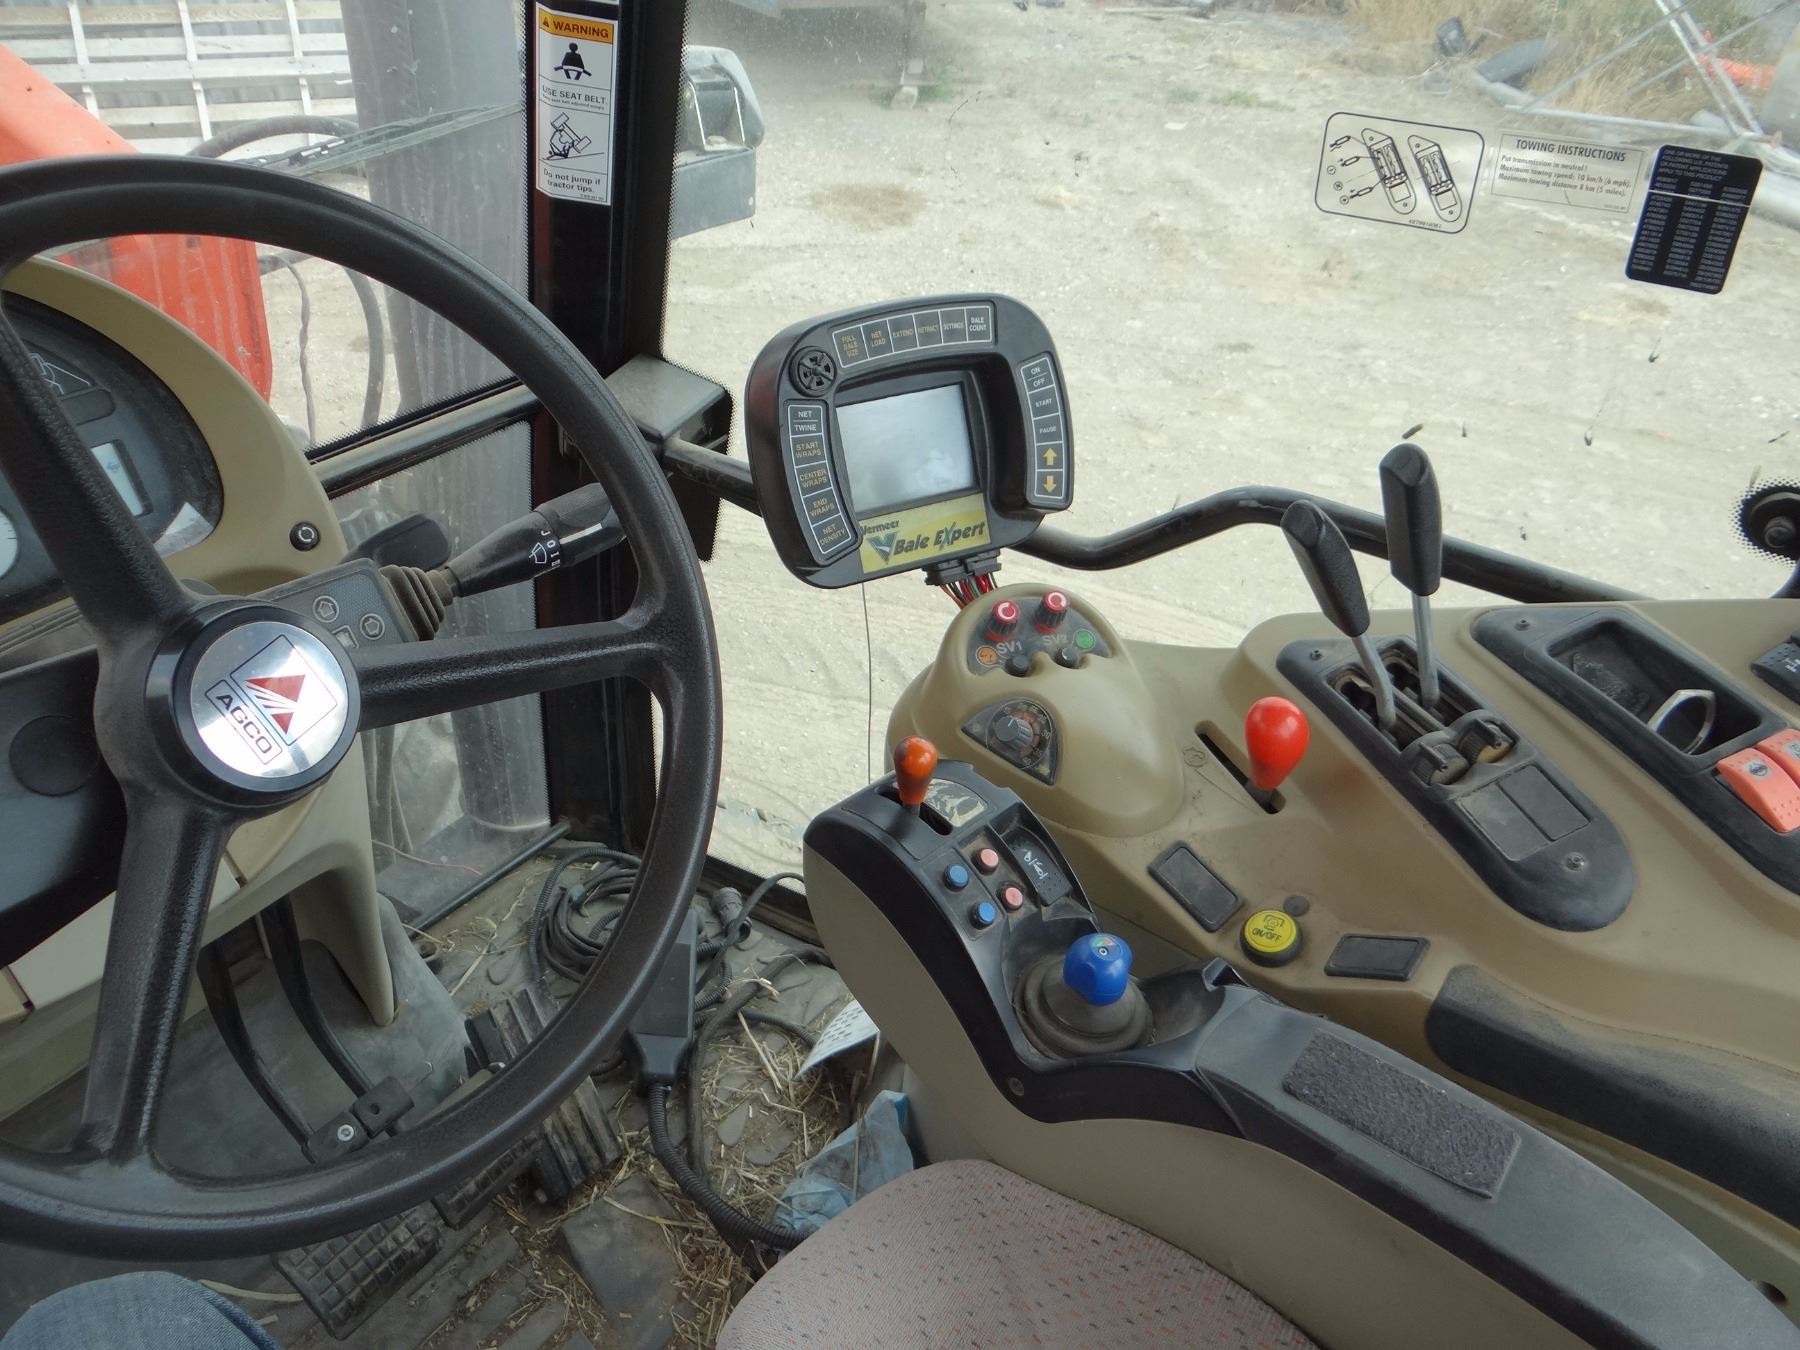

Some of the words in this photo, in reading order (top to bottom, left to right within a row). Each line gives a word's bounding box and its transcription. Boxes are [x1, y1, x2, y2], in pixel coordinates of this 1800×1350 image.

[553, 20, 609, 38] WARNING
[542, 85, 557, 97] USE
[559, 90, 582, 100] SEAT
[1516, 139, 1554, 152] TOWING
[1557, 144, 1626, 161] INSTRUCTIONS
[543, 168, 553, 178] Do
[555, 173, 569, 181] not
[571, 175, 593, 186] jump
[1500, 164, 1530, 174] Maximum
[1530, 168, 1552, 178] towing
[547, 179, 575, 190] tractor
[1499, 173, 1528, 183] Maximum
[1528, 178, 1551, 188] towing
[1552, 180, 1578, 191] distance
[970, 316, 984, 324] BALE
[893, 328, 914, 339] EXTEND
[969, 324, 987, 332] COUNT
[871, 330, 881, 339] NET
[871, 338, 886, 347] LOAD
[1030, 366, 1041, 375] ON
[1033, 377, 1045, 388] OFF
[1035, 398, 1052, 408] START
[798, 410, 813, 418] NET
[794, 424, 817, 432] TWINE
[1039, 426, 1057, 435] PAUSE
[796, 441, 819, 451] START
[796, 449, 822, 459] WRAPS
[799, 469, 827, 482] CENTER
[802, 477, 828, 489] WRAPS
[813, 497, 828, 509] END
[810, 504, 835, 518] WRAPS
[823, 523, 837, 535] NET
[819, 528, 846, 546] DENSITY
[893, 534, 930, 556] Bale
[1042, 634, 1067, 646] SV2
[996, 641, 1022, 654] SV1
[216, 694, 272, 754] AGCO
[1252, 927, 1282, 942] ON/OFF
